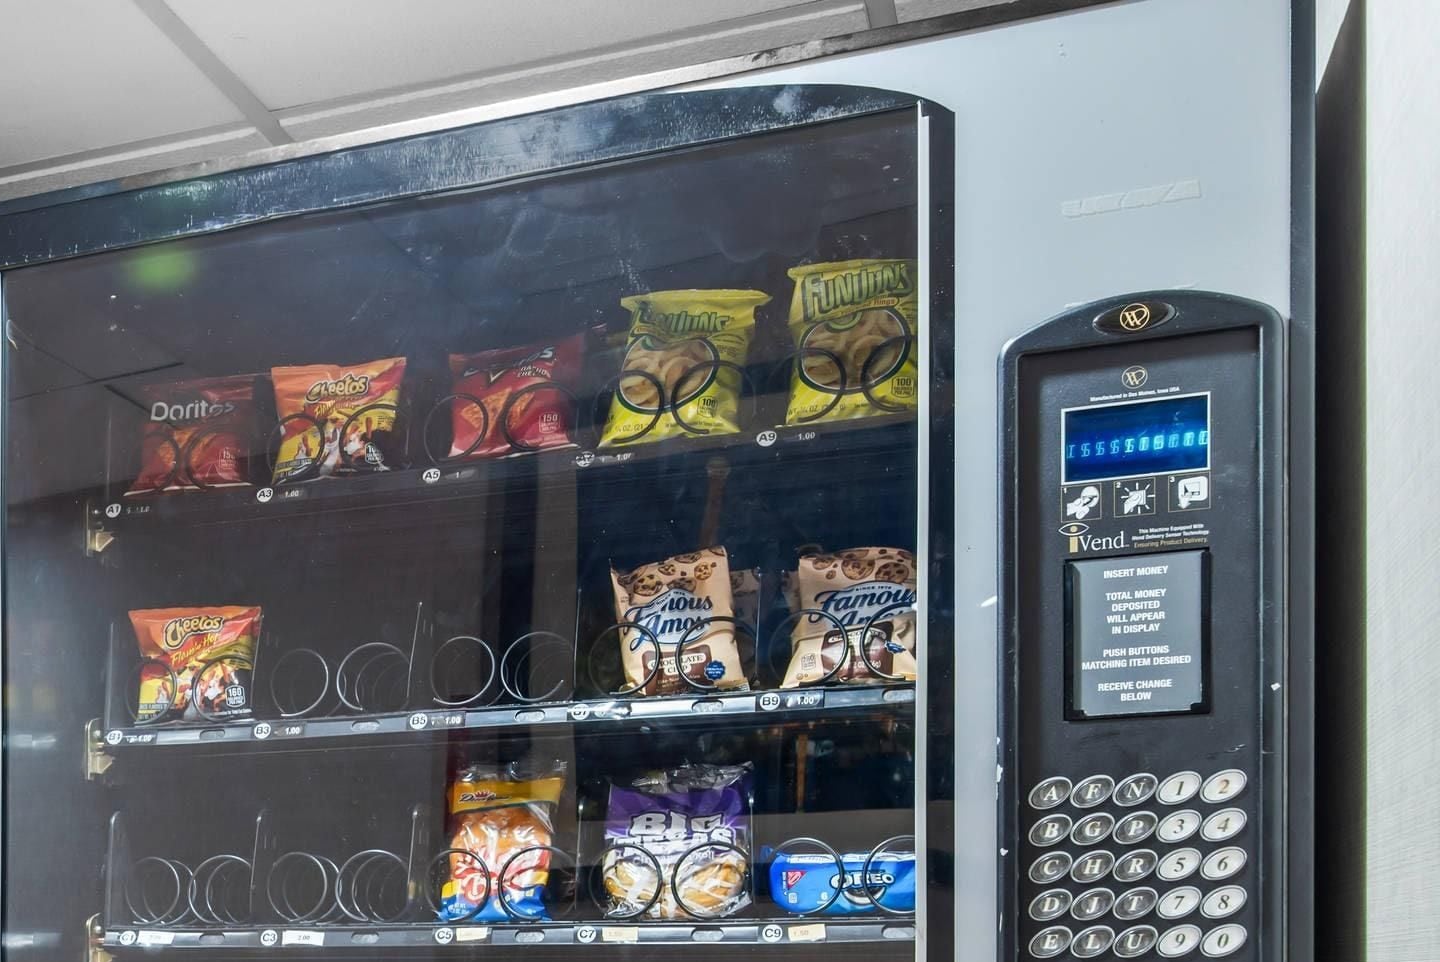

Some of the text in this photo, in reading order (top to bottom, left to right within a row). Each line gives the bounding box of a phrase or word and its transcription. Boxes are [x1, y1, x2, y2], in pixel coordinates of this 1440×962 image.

[306, 374, 369, 402] Cheetos
[1090, 393, 1122, 402] Manufactured
[758, 432, 816, 442] A9 1.00
[425, 470, 440, 479] A5
[258, 489, 272, 499] A3
[1183, 529, 1210, 537] Technology
[1134, 541, 1159, 549] Ensuring
[1103, 565, 1169, 579] INSERT MONEY
[1105, 588, 1167, 601] TOTAL MONEY
[1111, 600, 1161, 612] DEPOSITED
[1106, 611, 1166, 624] WILL APPEAR
[165, 615, 224, 648] Cheetos
[1111, 623, 1161, 635] IN DISPLAY
[1103, 645, 1170, 658] PUSH BUTTONS
[1081, 655, 1192, 671] MATCHING ITEM DESIRED
[228, 687, 242, 697] 160
[1097, 679, 1173, 692] RECEIVE CHANGE
[762, 696, 779, 706] B9
[1120, 692, 1152, 702] BELOW
[411, 715, 461, 725] B5 1.00
[256, 725, 301, 735] B3 1.00
[1043, 786, 1058, 801] A
[1085, 783, 1102, 799] F
[1126, 781, 1145, 799] N
[1175, 781, 1184, 796] 1
[1218, 779, 1230, 795] 2
[630, 811, 723, 836] BIG
[1044, 822, 1059, 838] B
[1085, 821, 1102, 837] G
[1128, 820, 1144, 836] P
[1173, 818, 1185, 834] 3
[1217, 817, 1230, 833] 4
[1043, 859, 1059, 875] C
[1083, 858, 1103, 875] H
[1127, 858, 1144, 875] R
[1174, 857, 1187, 873] 5
[1217, 856, 1229, 871] 6
[830, 871, 895, 889] OREO
[1042, 897, 1060, 912] D
[1086, 896, 1101, 914] J
[1128, 895, 1144, 912] T
[1174, 895, 1185, 910] 7
[1217, 894, 1230, 911] 8
[262, 933, 277, 942] C3
[436, 930, 452, 940] C5
[579, 929, 595, 939] C7
[764, 928, 781, 938] C9
[1043, 934, 1059, 950] E
[1086, 933, 1101, 950] L
[1127, 933, 1145, 950] U
[1175, 933, 1186, 949] 9
[1217, 933, 1229, 949] 0
